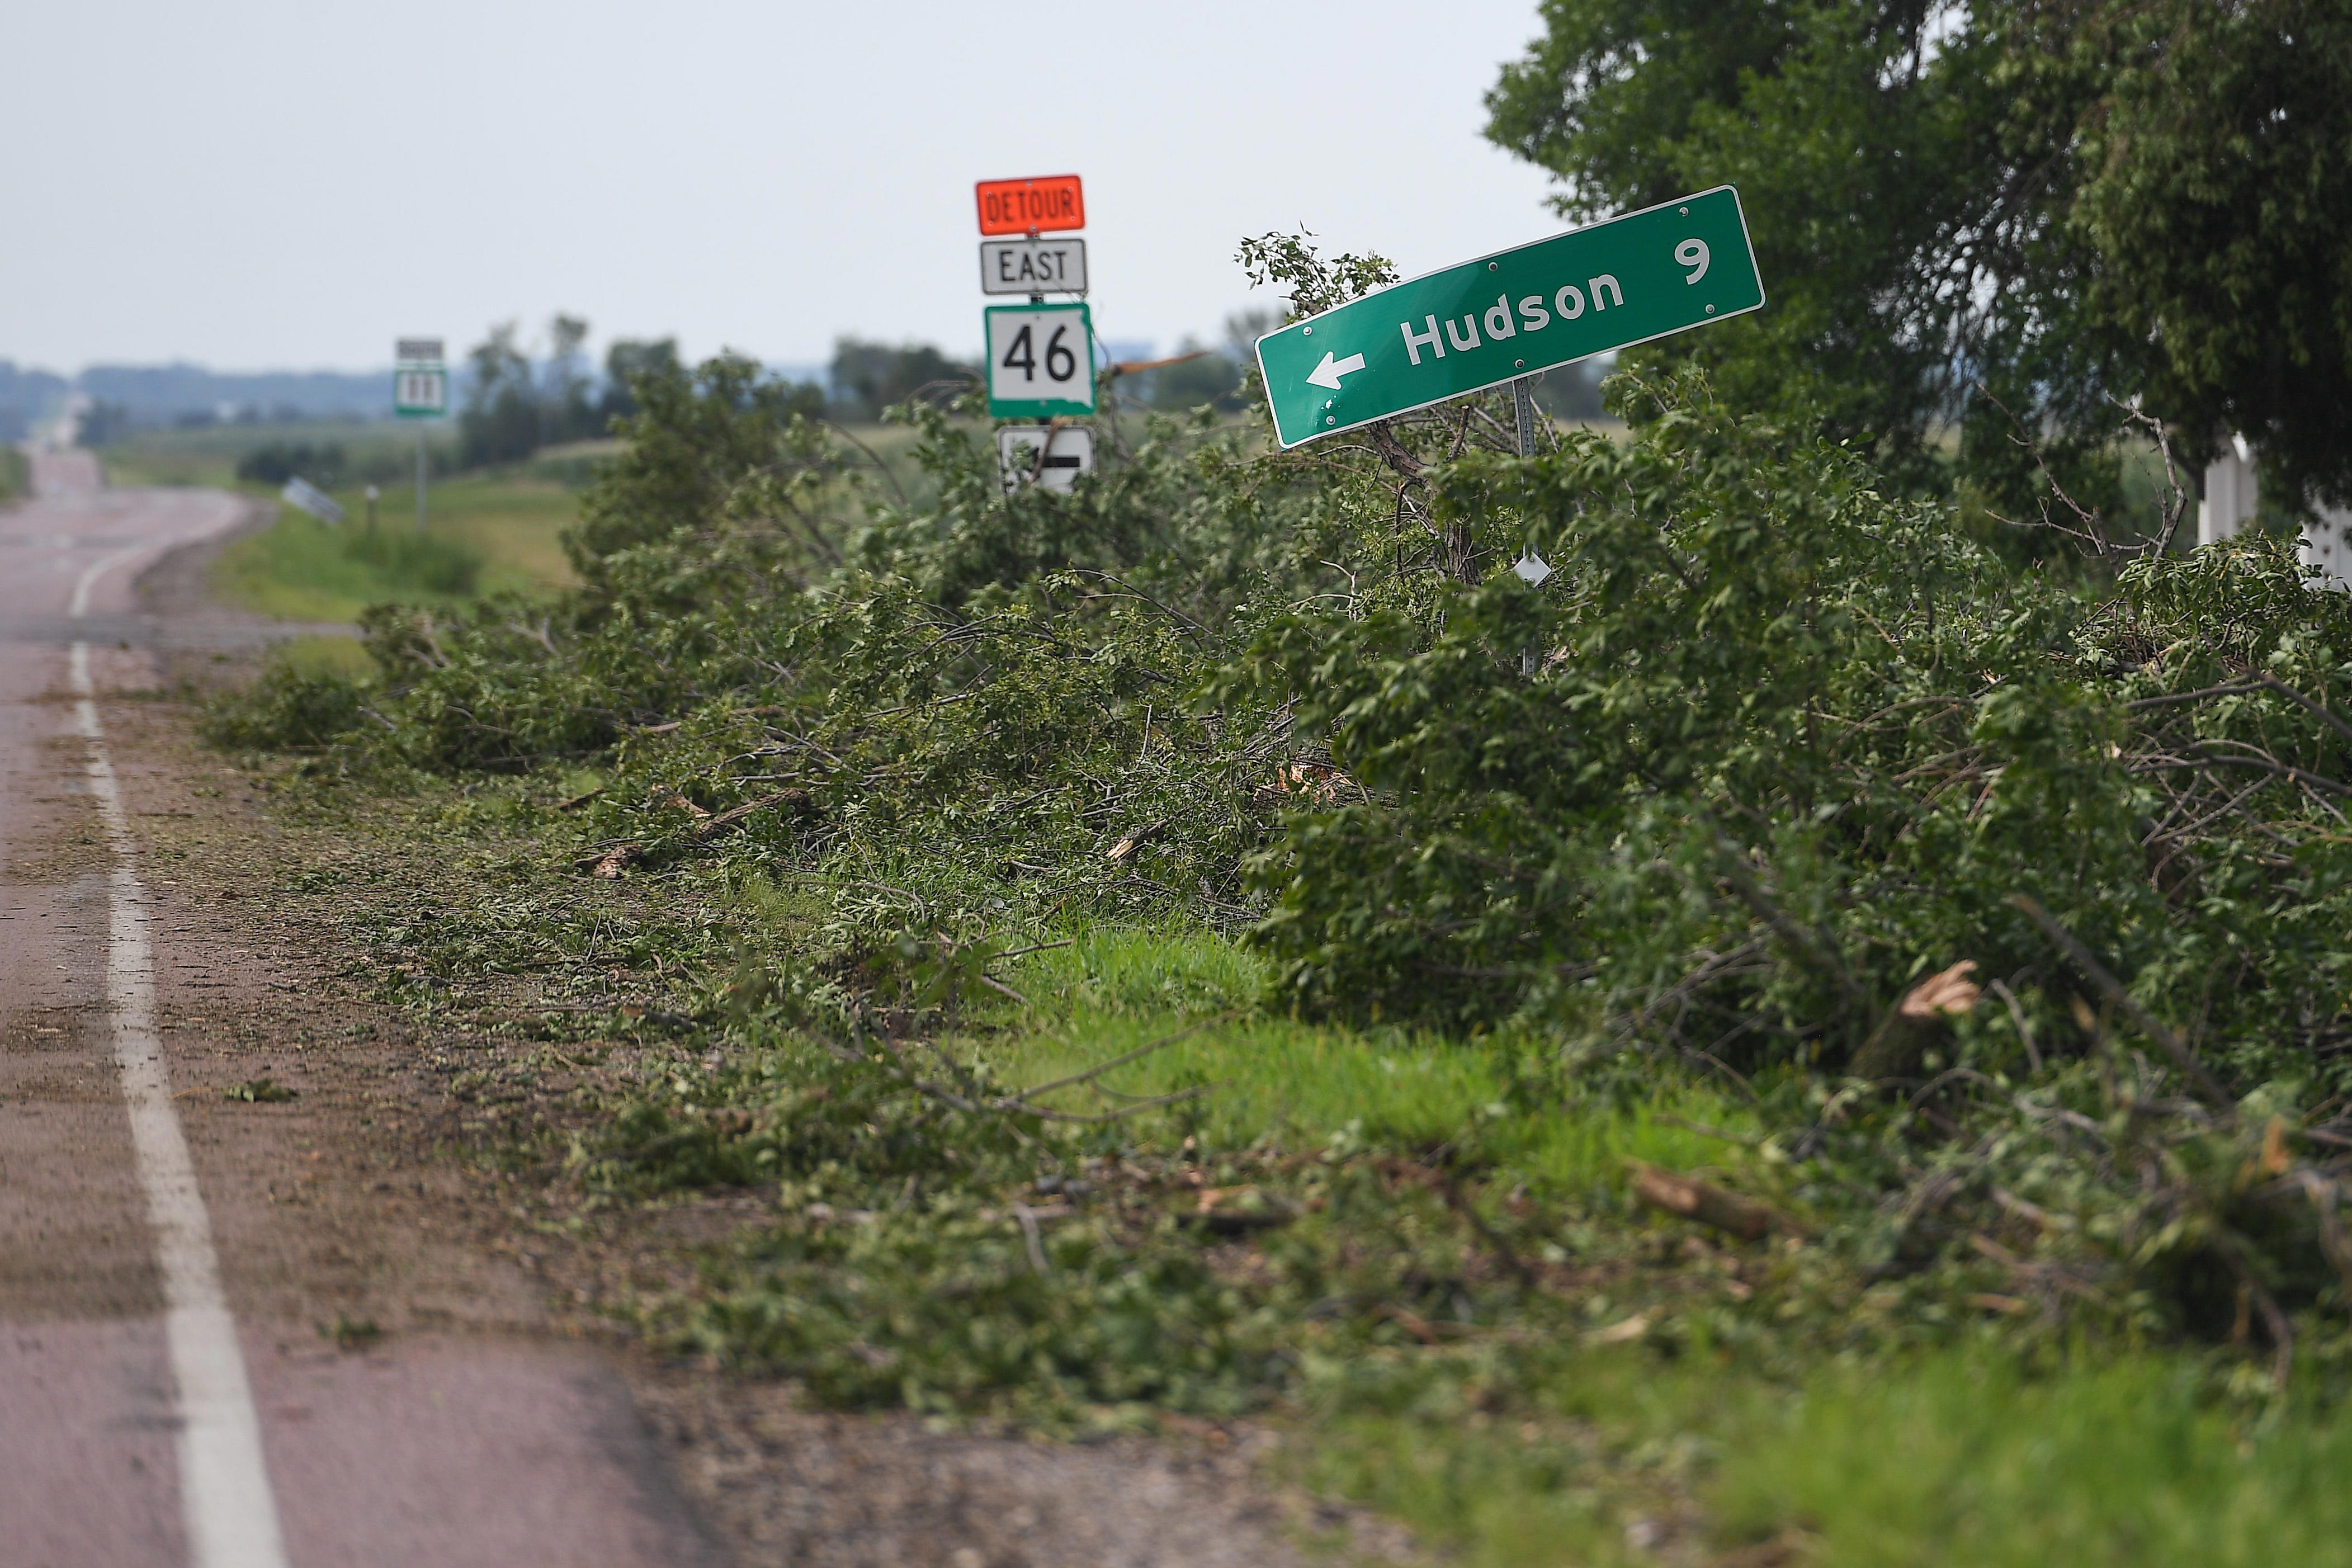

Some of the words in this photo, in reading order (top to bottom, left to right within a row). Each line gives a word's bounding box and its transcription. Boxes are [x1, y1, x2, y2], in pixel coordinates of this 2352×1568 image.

[986, 189, 1074, 222] DETOUR
[999, 251, 1066, 282] EAST
[1400, 273, 1624, 365] Hudson
[1674, 238, 1711, 285] 9
[1003, 325, 1075, 381] 46
